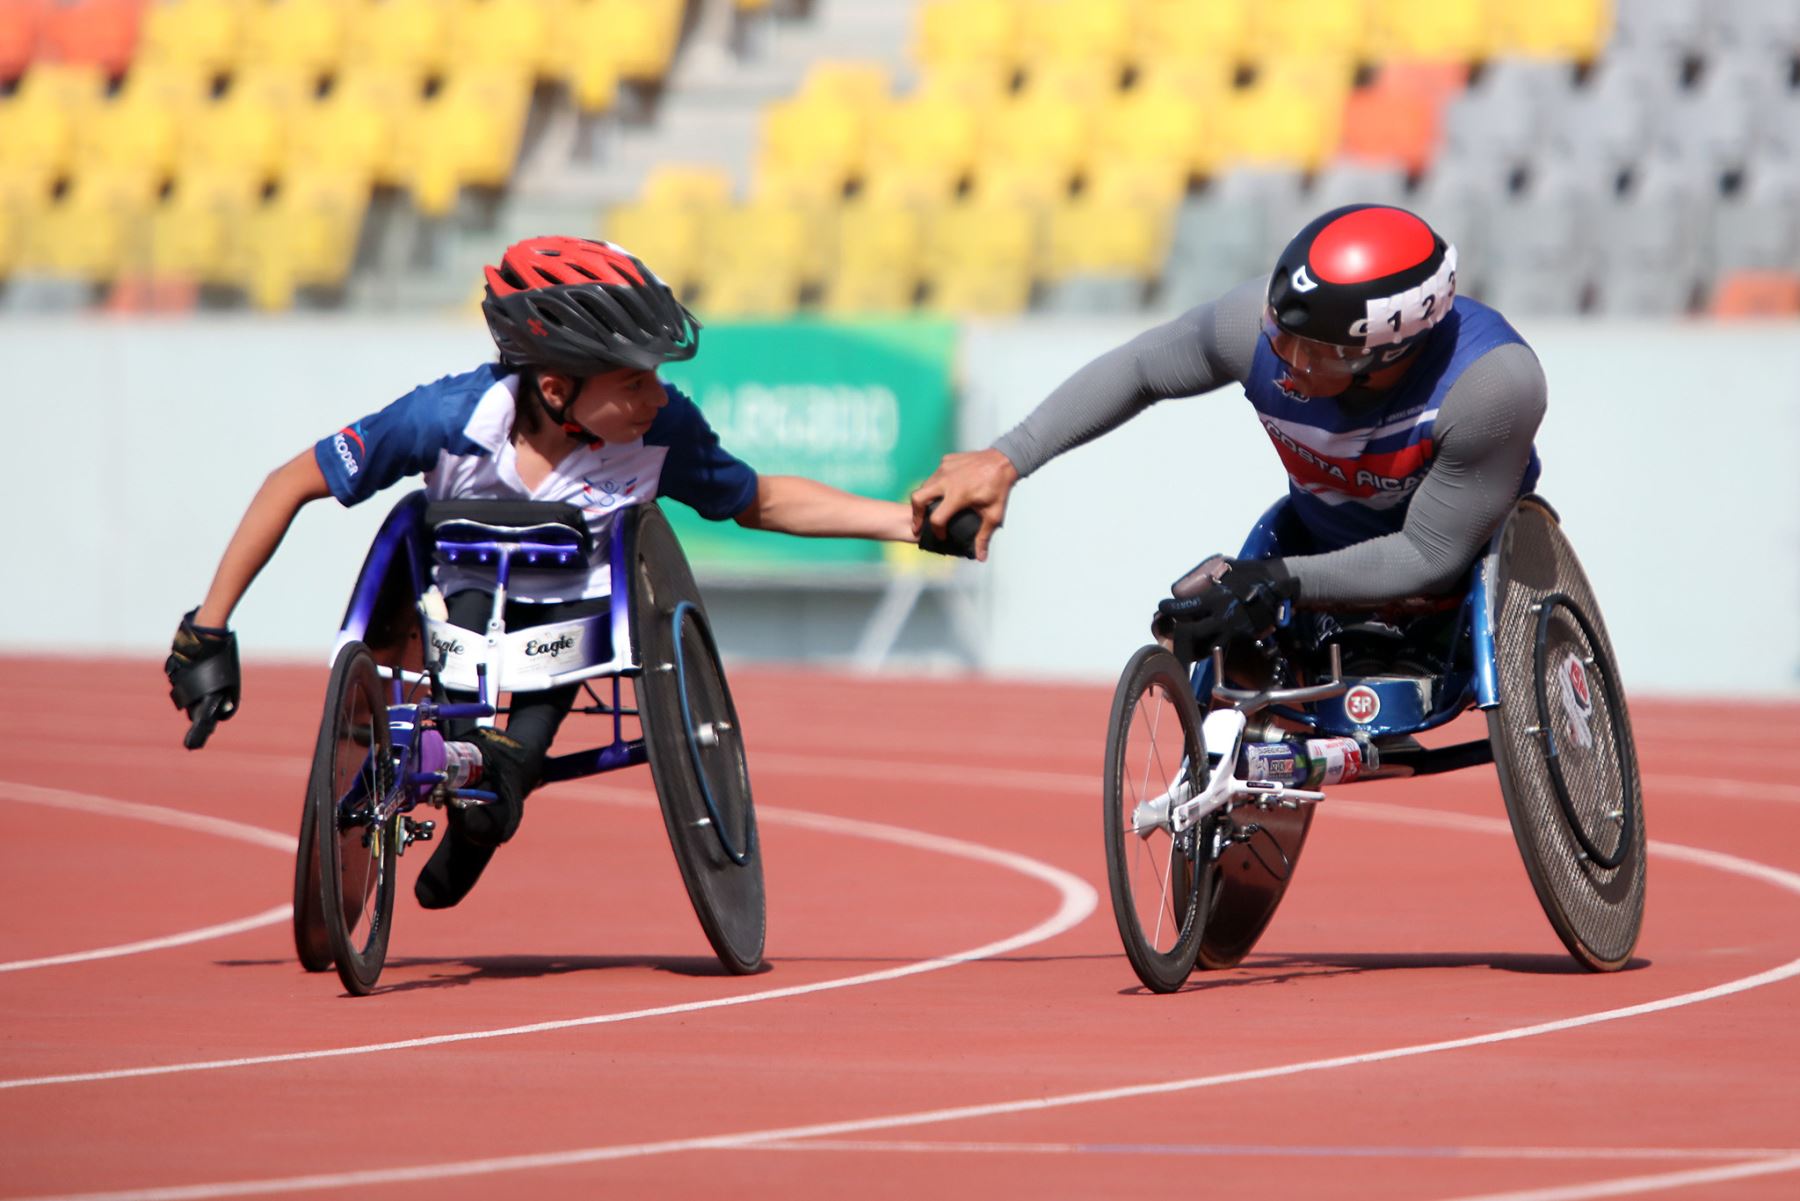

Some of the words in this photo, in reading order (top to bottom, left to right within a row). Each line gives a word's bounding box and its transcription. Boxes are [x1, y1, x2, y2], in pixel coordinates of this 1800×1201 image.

[1266, 421, 1347, 482] COSTA
[525, 634, 575, 657] Eagle
[1351, 695, 1373, 714] 3R
